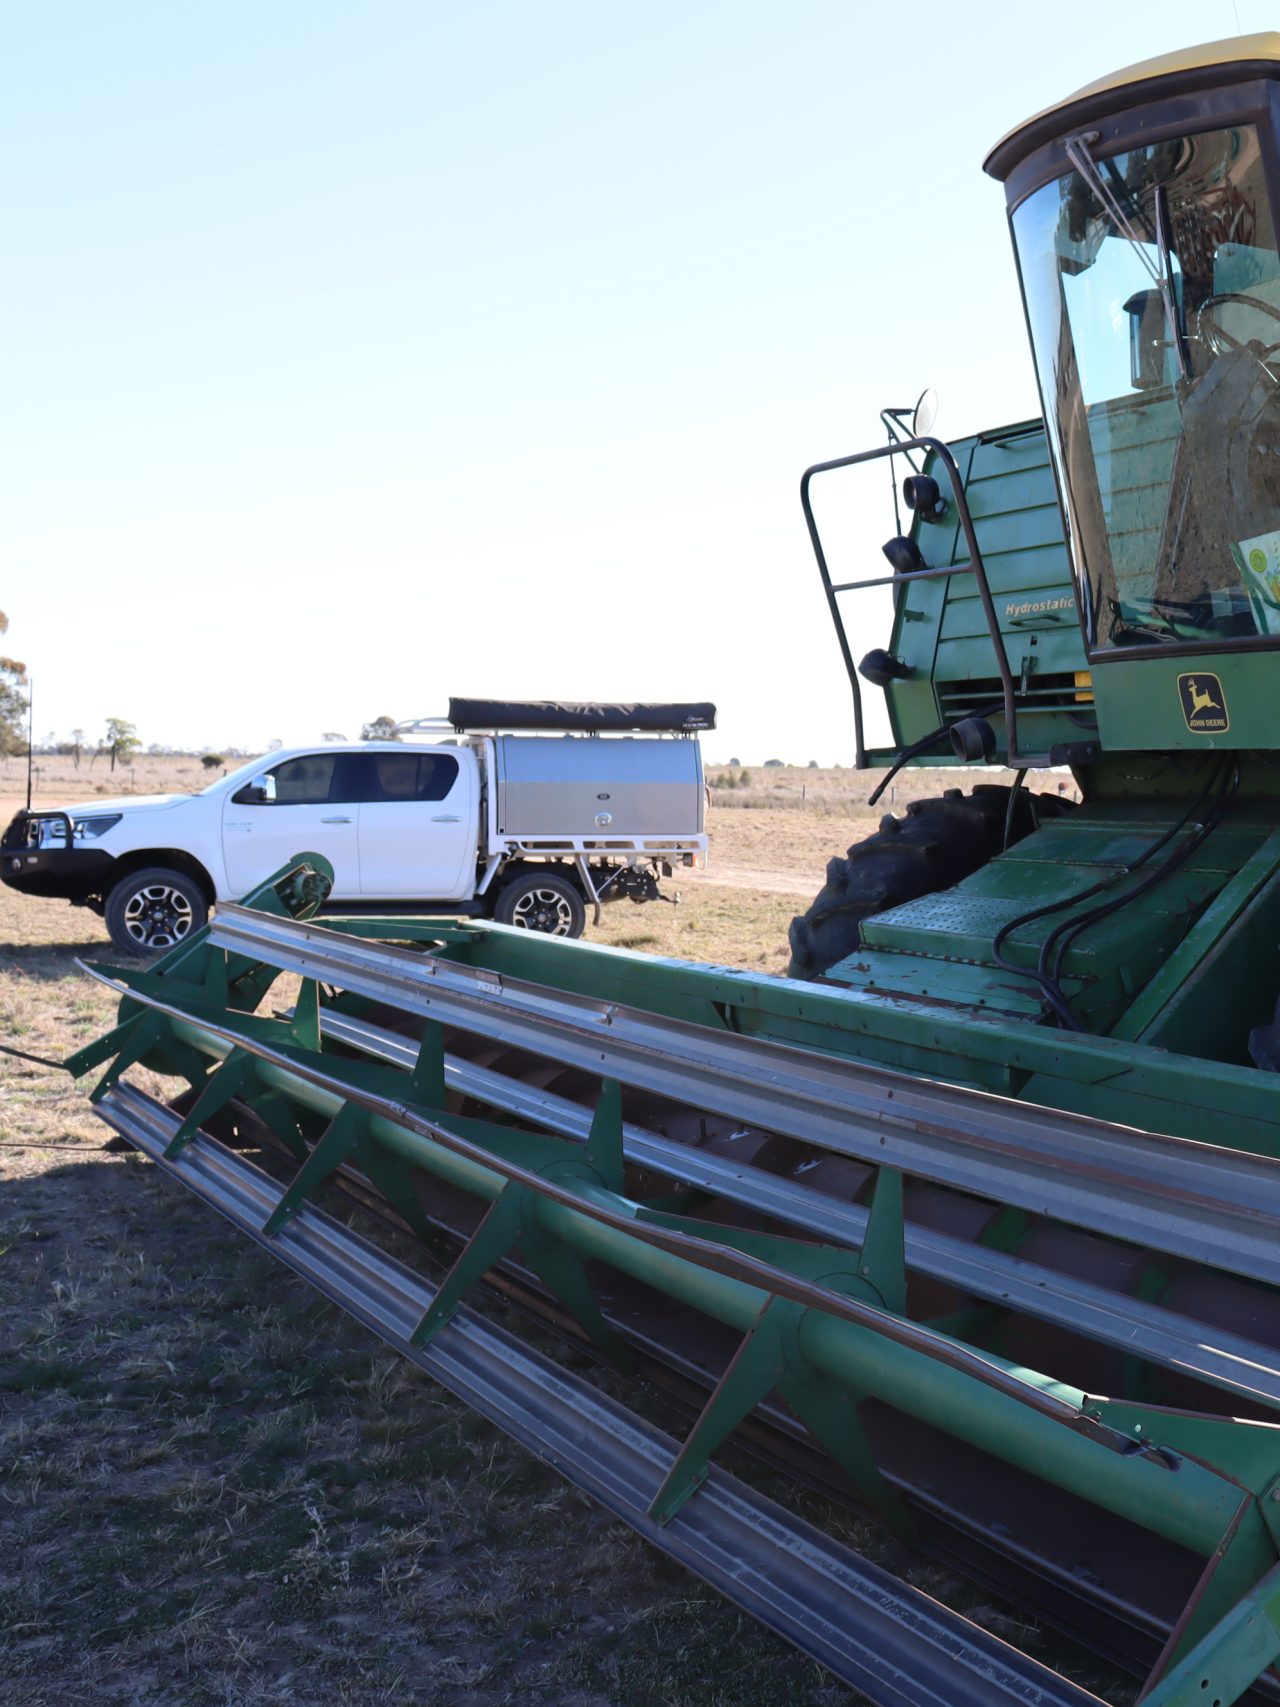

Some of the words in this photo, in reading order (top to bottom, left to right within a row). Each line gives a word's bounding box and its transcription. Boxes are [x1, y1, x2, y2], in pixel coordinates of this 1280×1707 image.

[1006, 597, 1074, 617] Hydrostatic
[1189, 719, 1205, 727] JOHN
[1206, 719, 1226, 727] DEERE
